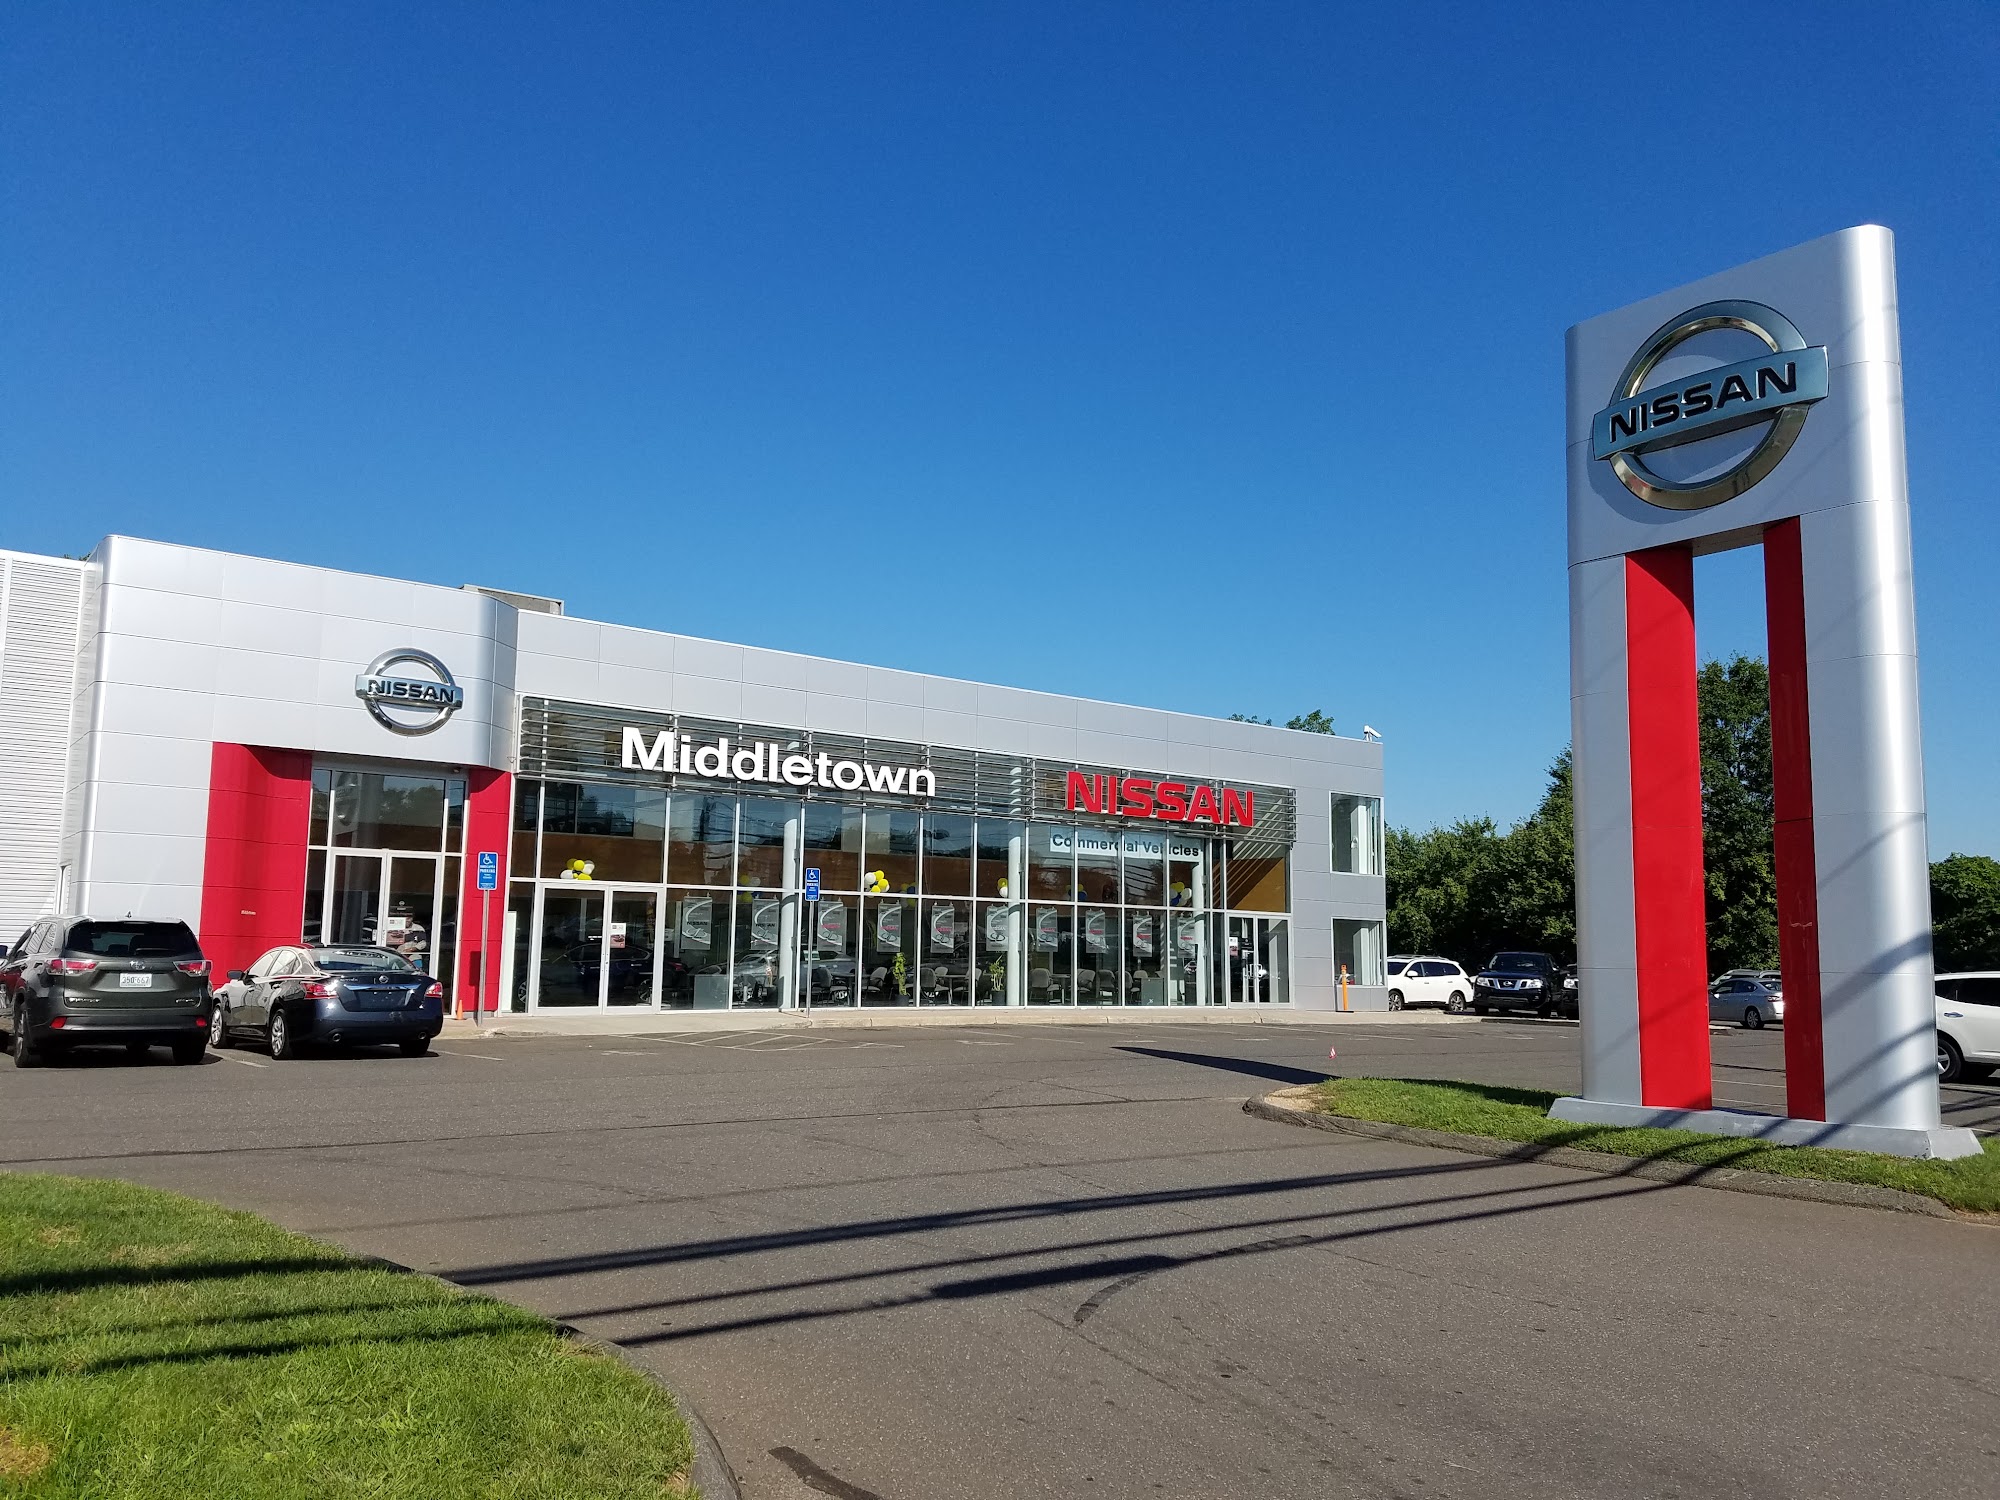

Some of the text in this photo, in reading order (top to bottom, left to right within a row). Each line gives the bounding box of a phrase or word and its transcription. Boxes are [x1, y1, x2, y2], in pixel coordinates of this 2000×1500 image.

[1609, 361, 1798, 443] NISSAN
[368, 679, 456, 704] NISSAN
[621, 727, 936, 796] Middletown
[1066, 770, 1255, 828] NISSAN
